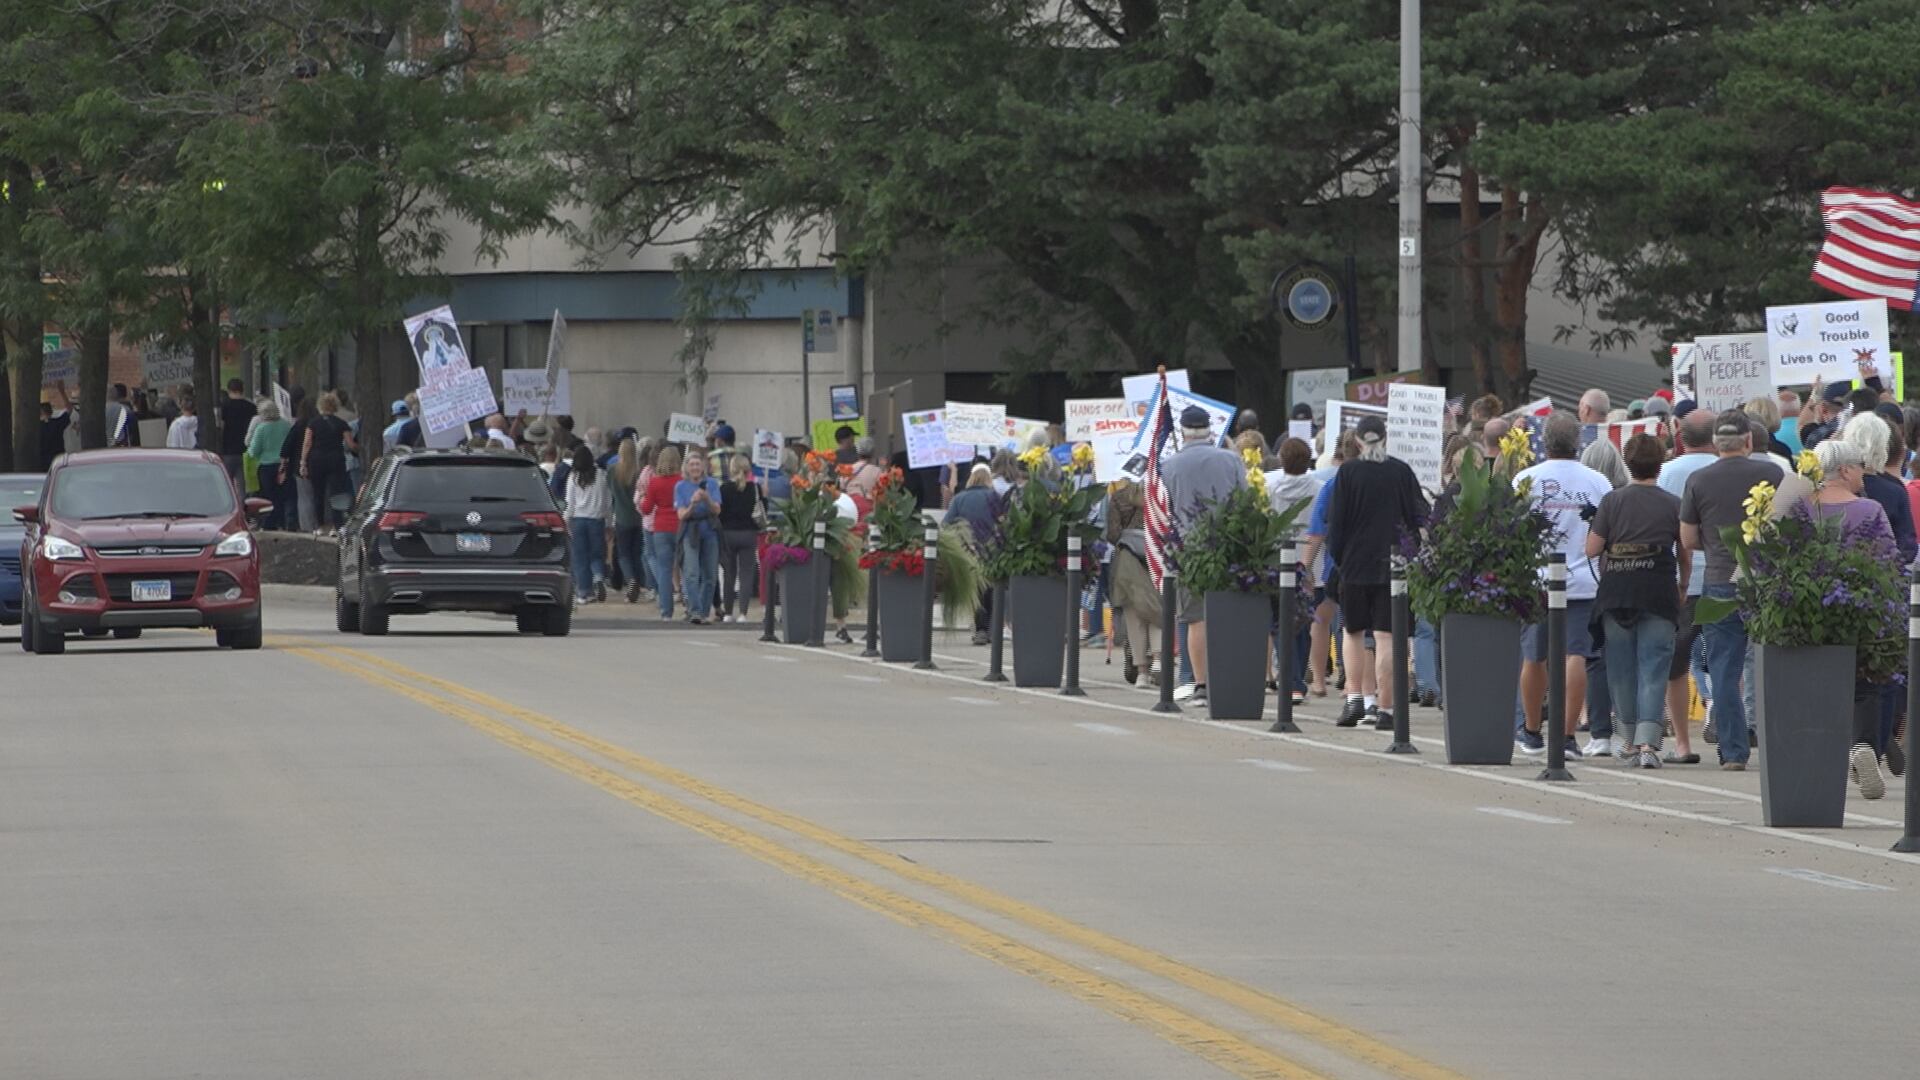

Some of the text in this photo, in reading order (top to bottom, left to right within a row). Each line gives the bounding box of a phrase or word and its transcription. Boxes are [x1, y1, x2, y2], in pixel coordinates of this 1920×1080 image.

[1402, 240, 1411, 254] 5
[1825, 311, 1860, 324] Good
[1819, 328, 1870, 342] Trouble
[1729, 342, 1753, 360] THE
[1780, 352, 1837, 365] Lives On
[149, 366, 192, 382] ASSISTIN
[1705, 384, 1743, 396] means
[1070, 402, 1123, 416] HANDS OFF
